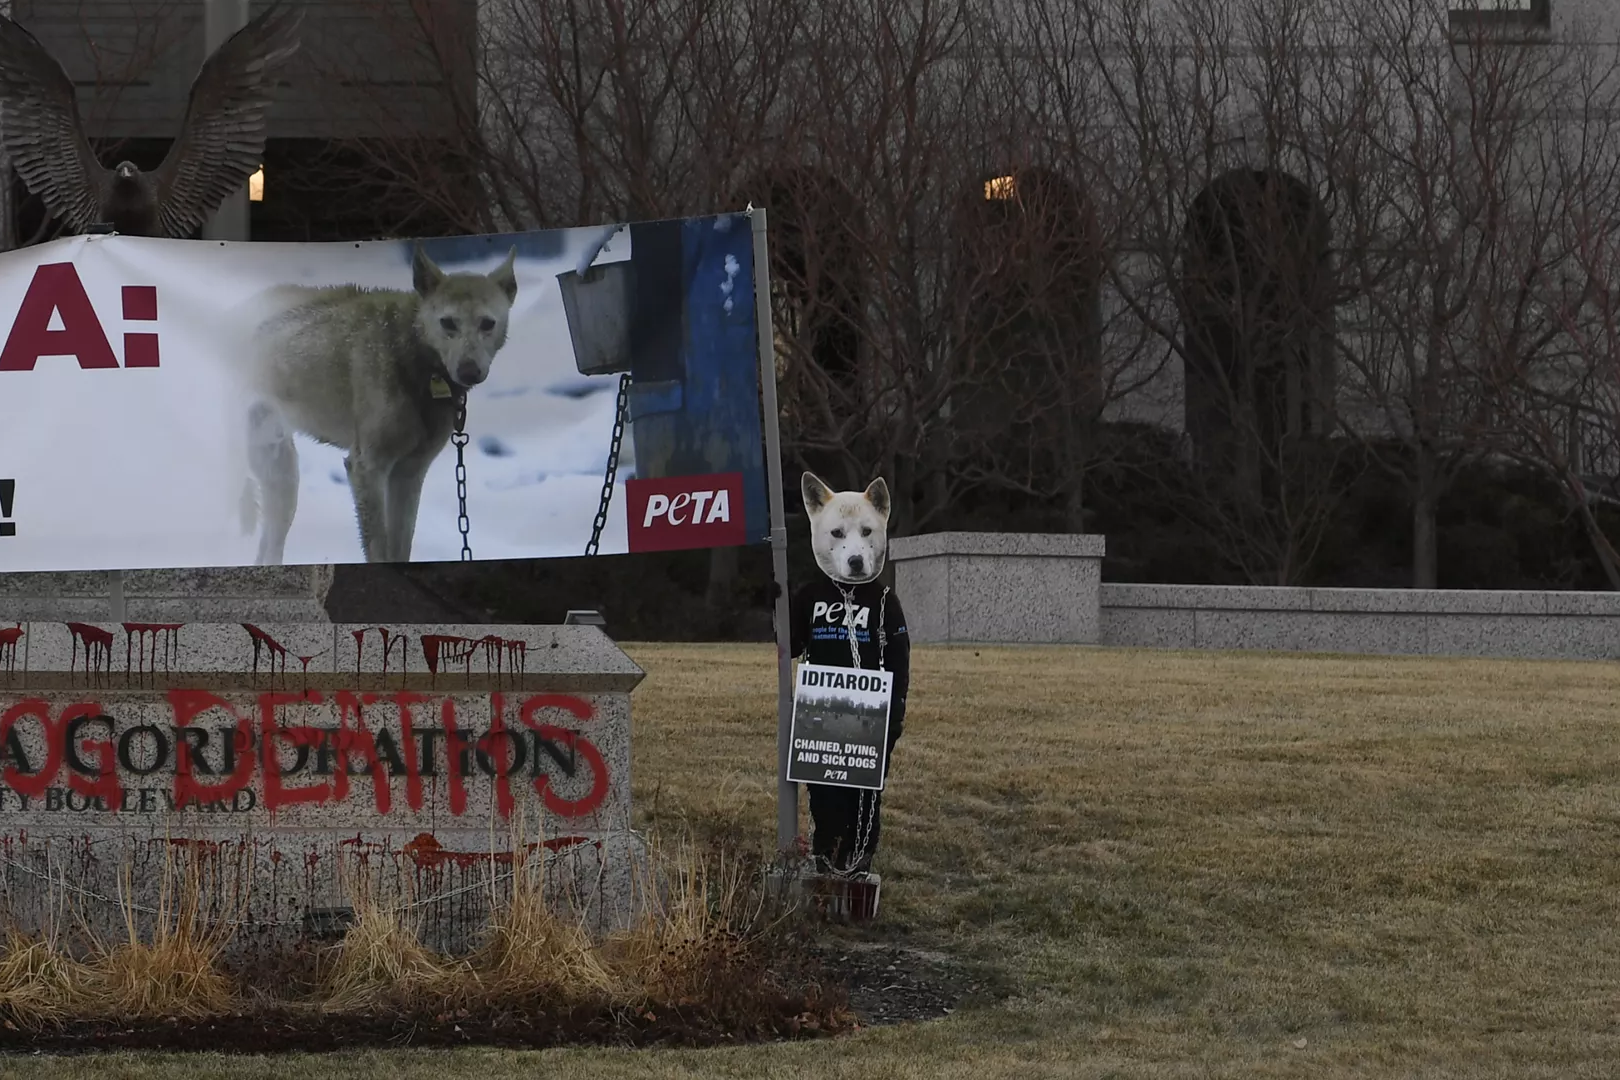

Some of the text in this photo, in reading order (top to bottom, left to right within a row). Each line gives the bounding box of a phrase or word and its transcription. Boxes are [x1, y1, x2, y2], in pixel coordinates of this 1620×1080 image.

[801, 670, 887, 693] IDITAROD:
[167, 687, 609, 820] DEATHS
[794, 738, 879, 759] CHAINED, DYING,
[797, 752, 877, 769] AND SICK DOGS
